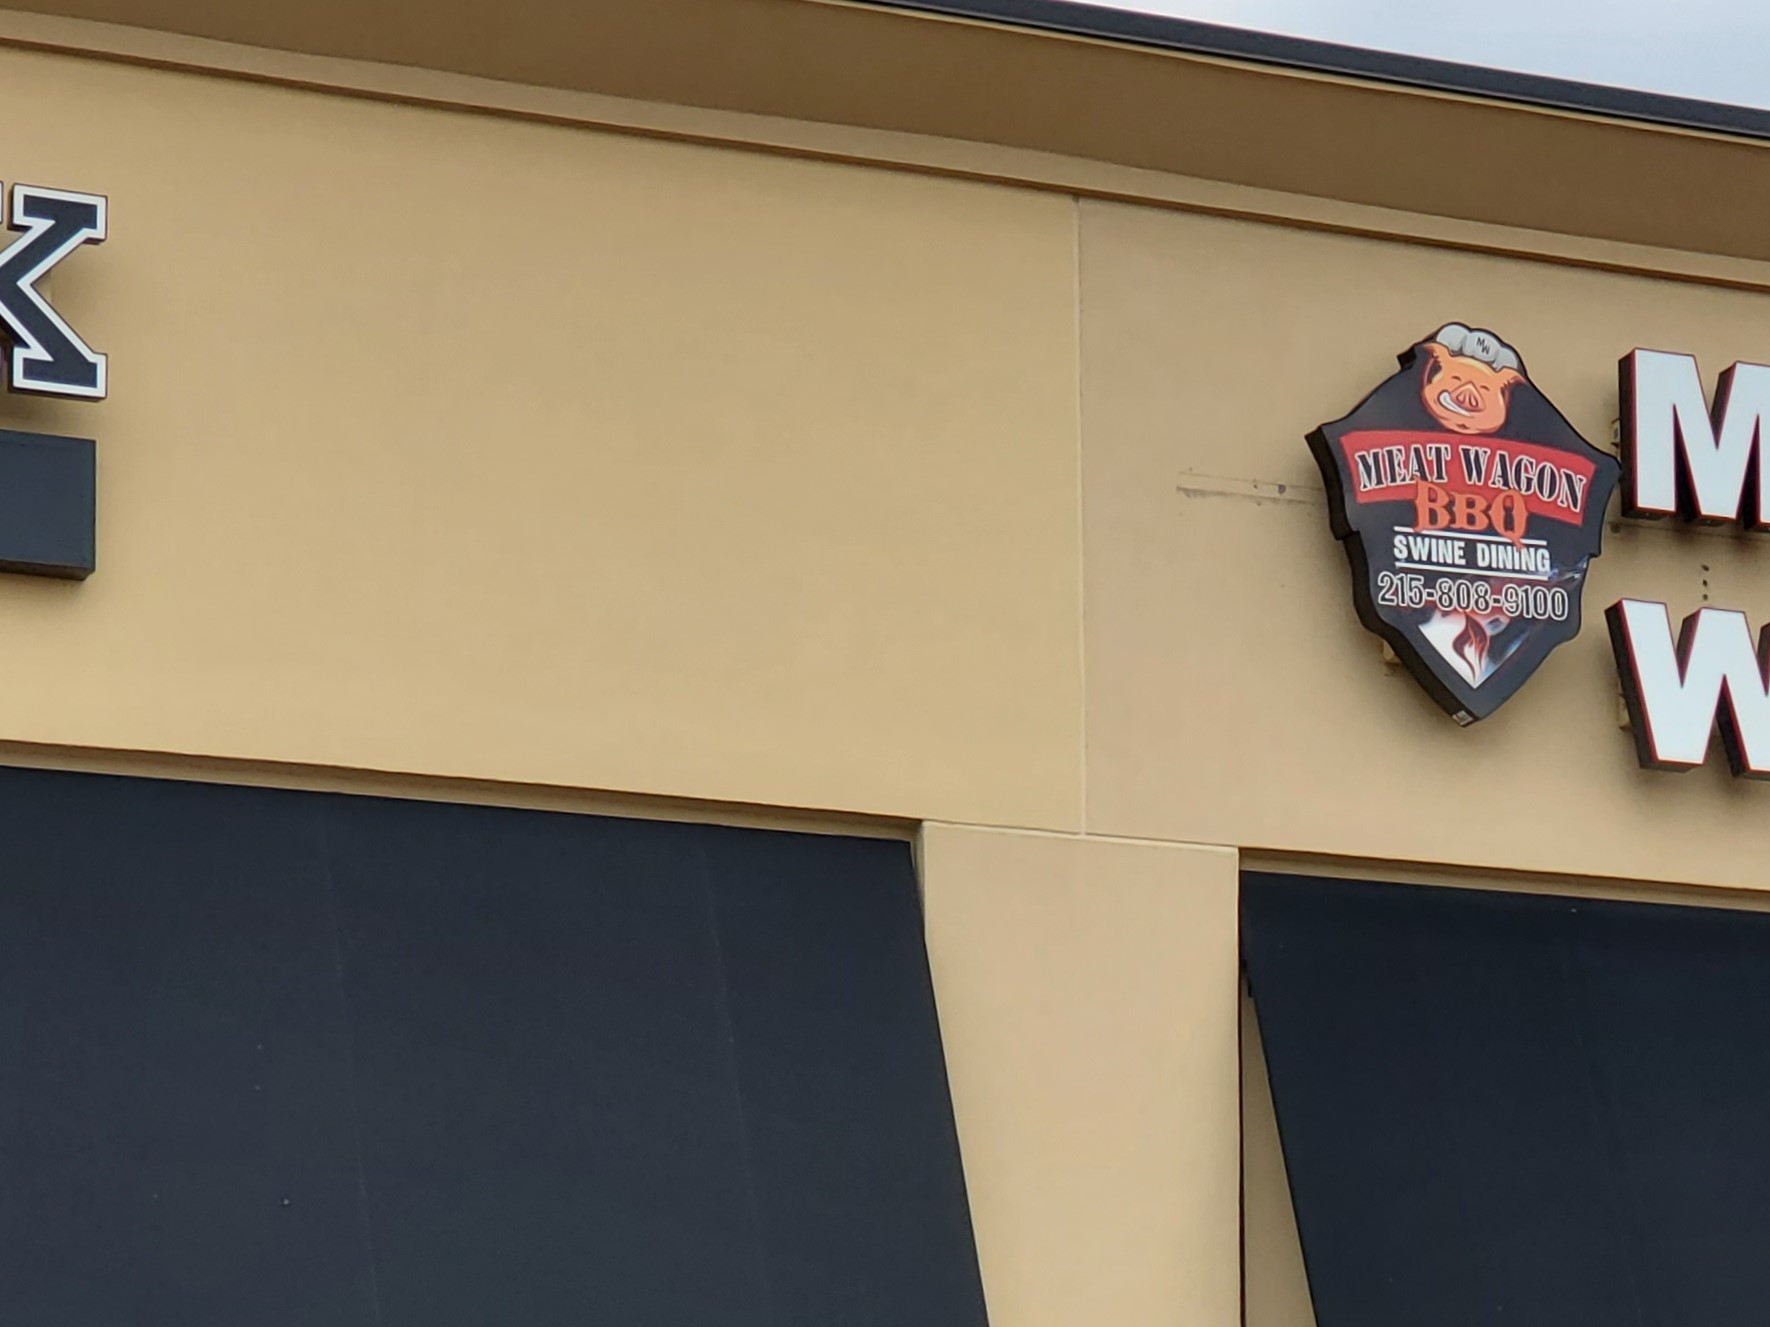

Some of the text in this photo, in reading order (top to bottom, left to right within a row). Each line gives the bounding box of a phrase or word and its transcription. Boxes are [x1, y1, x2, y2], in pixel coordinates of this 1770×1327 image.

[1355, 443, 1587, 513] MEAT WAGON
[1412, 475, 1529, 549] BBQ
[1394, 534, 1551, 573] SWINE DINING
[1377, 570, 1568, 621] 215-808-9100
